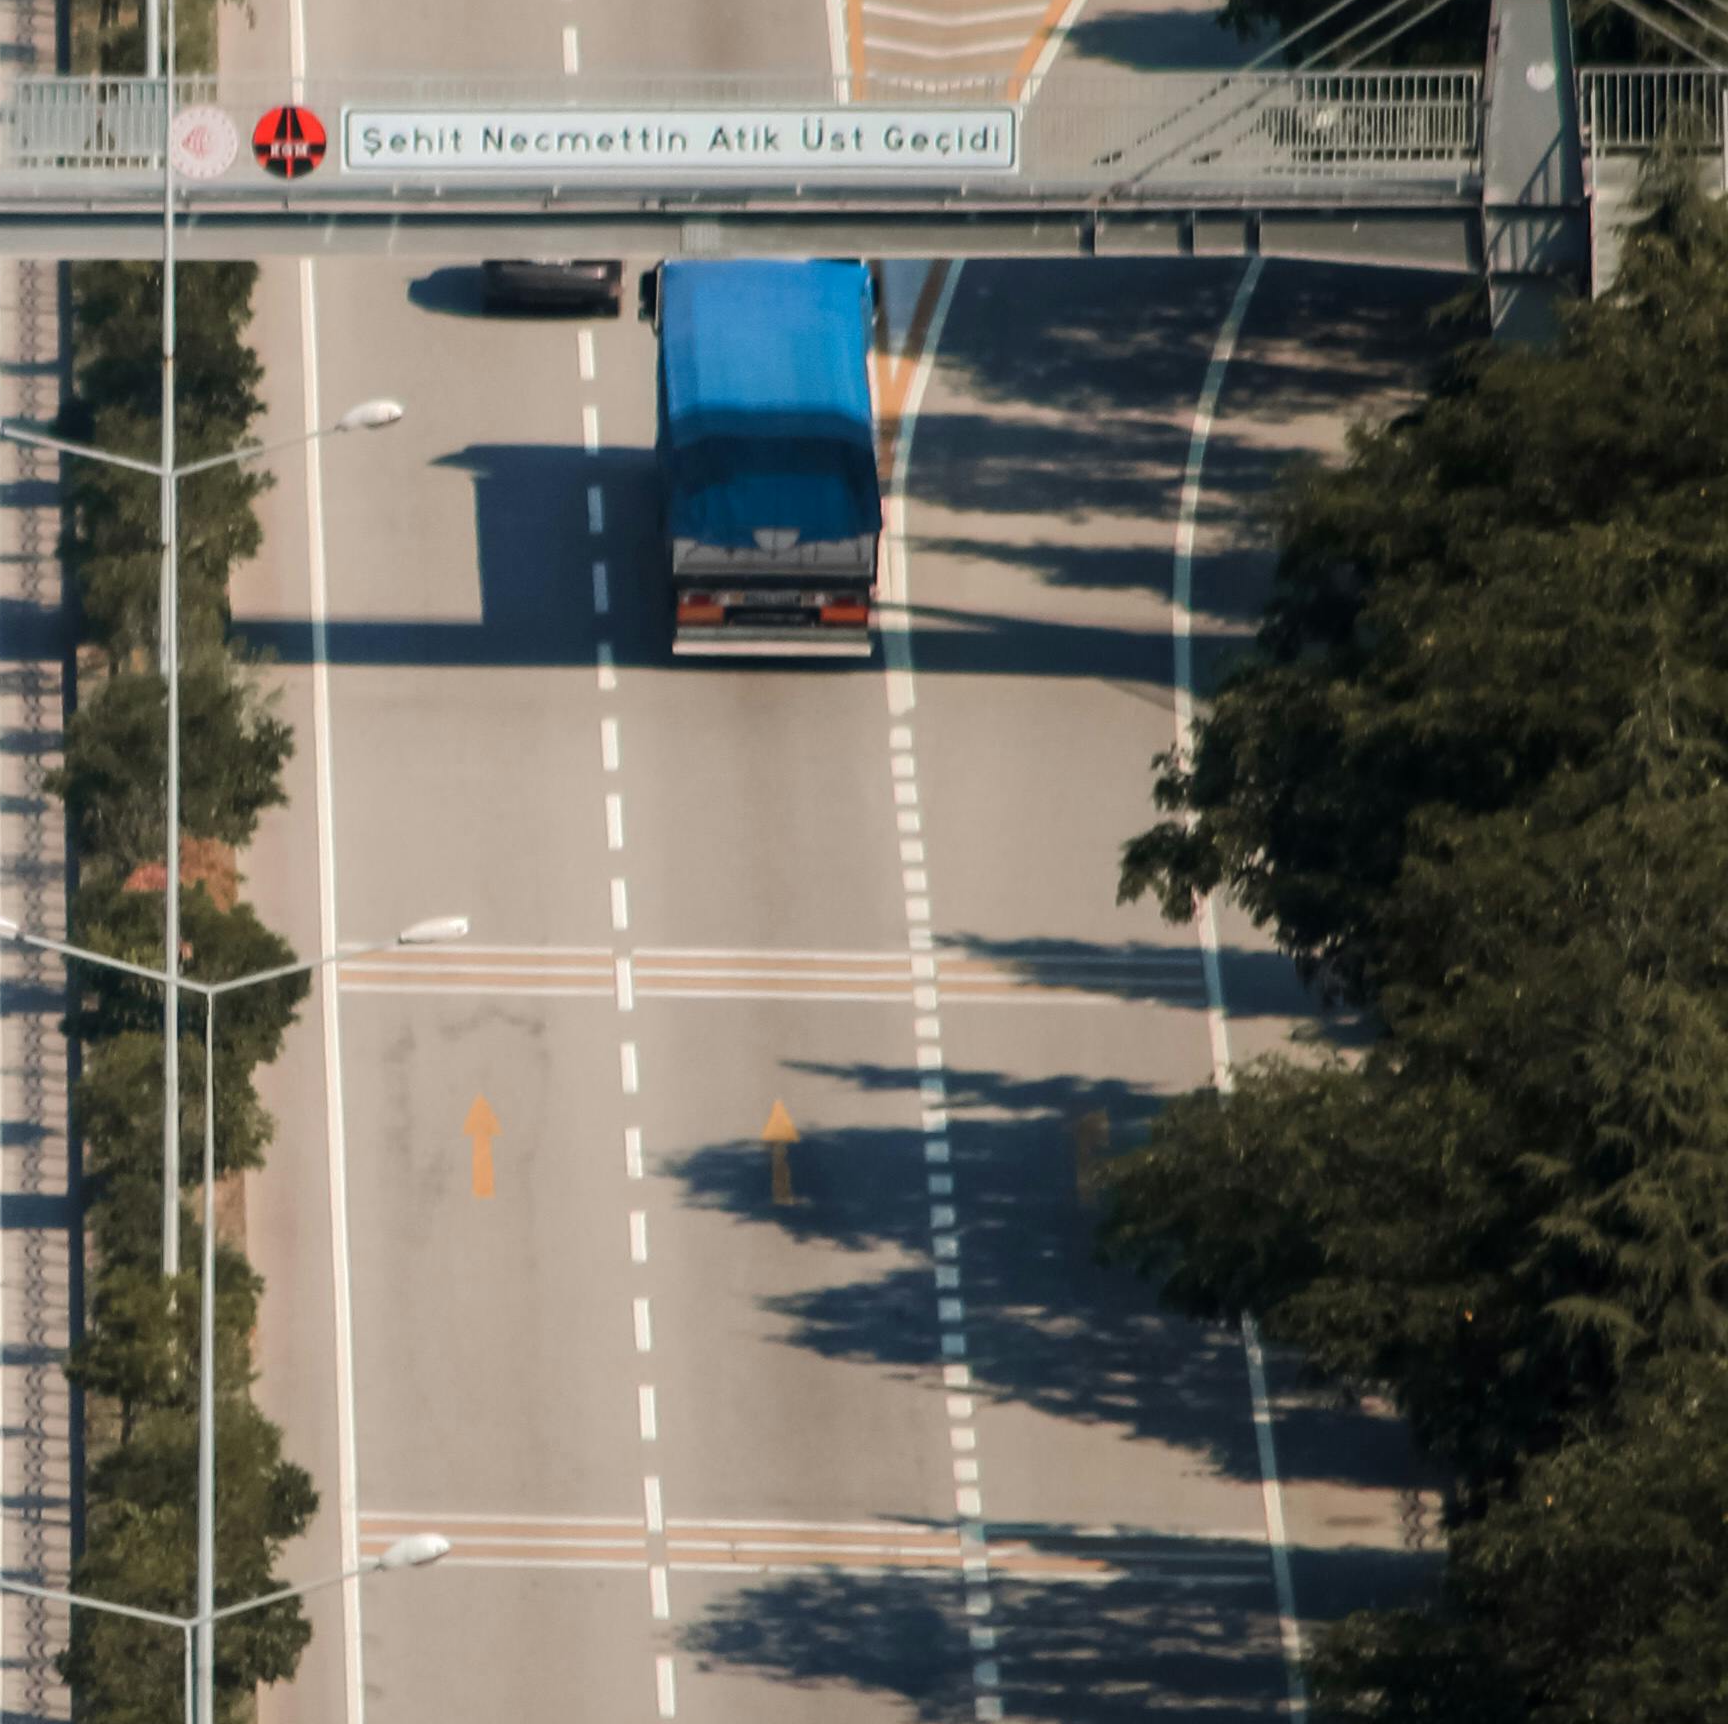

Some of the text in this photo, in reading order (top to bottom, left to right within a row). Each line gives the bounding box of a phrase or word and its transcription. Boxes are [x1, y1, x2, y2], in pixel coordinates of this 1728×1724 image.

[362, 116, 1000, 158] Şehit Necmettin Atik Üst Geçidi
